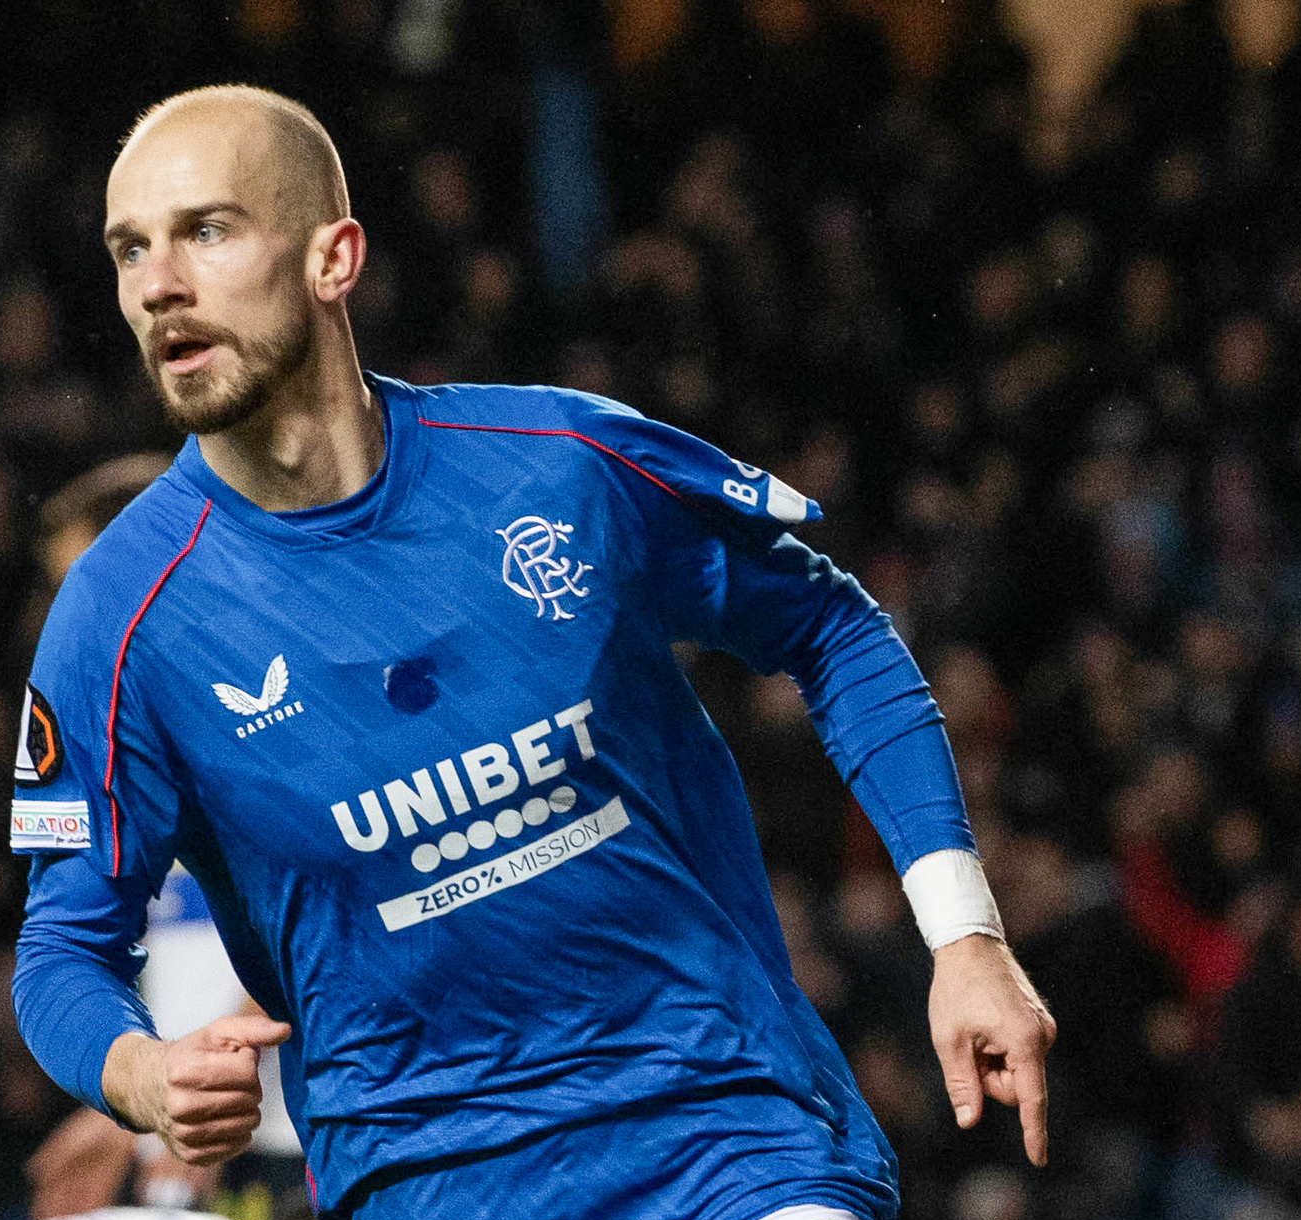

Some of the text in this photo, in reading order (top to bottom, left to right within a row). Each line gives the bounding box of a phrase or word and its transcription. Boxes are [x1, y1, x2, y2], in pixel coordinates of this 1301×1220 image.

[236, 701, 304, 739] CASTORE
[330, 698, 596, 852] UNIBET
[416, 818, 601, 914] ZERO% MISSION
